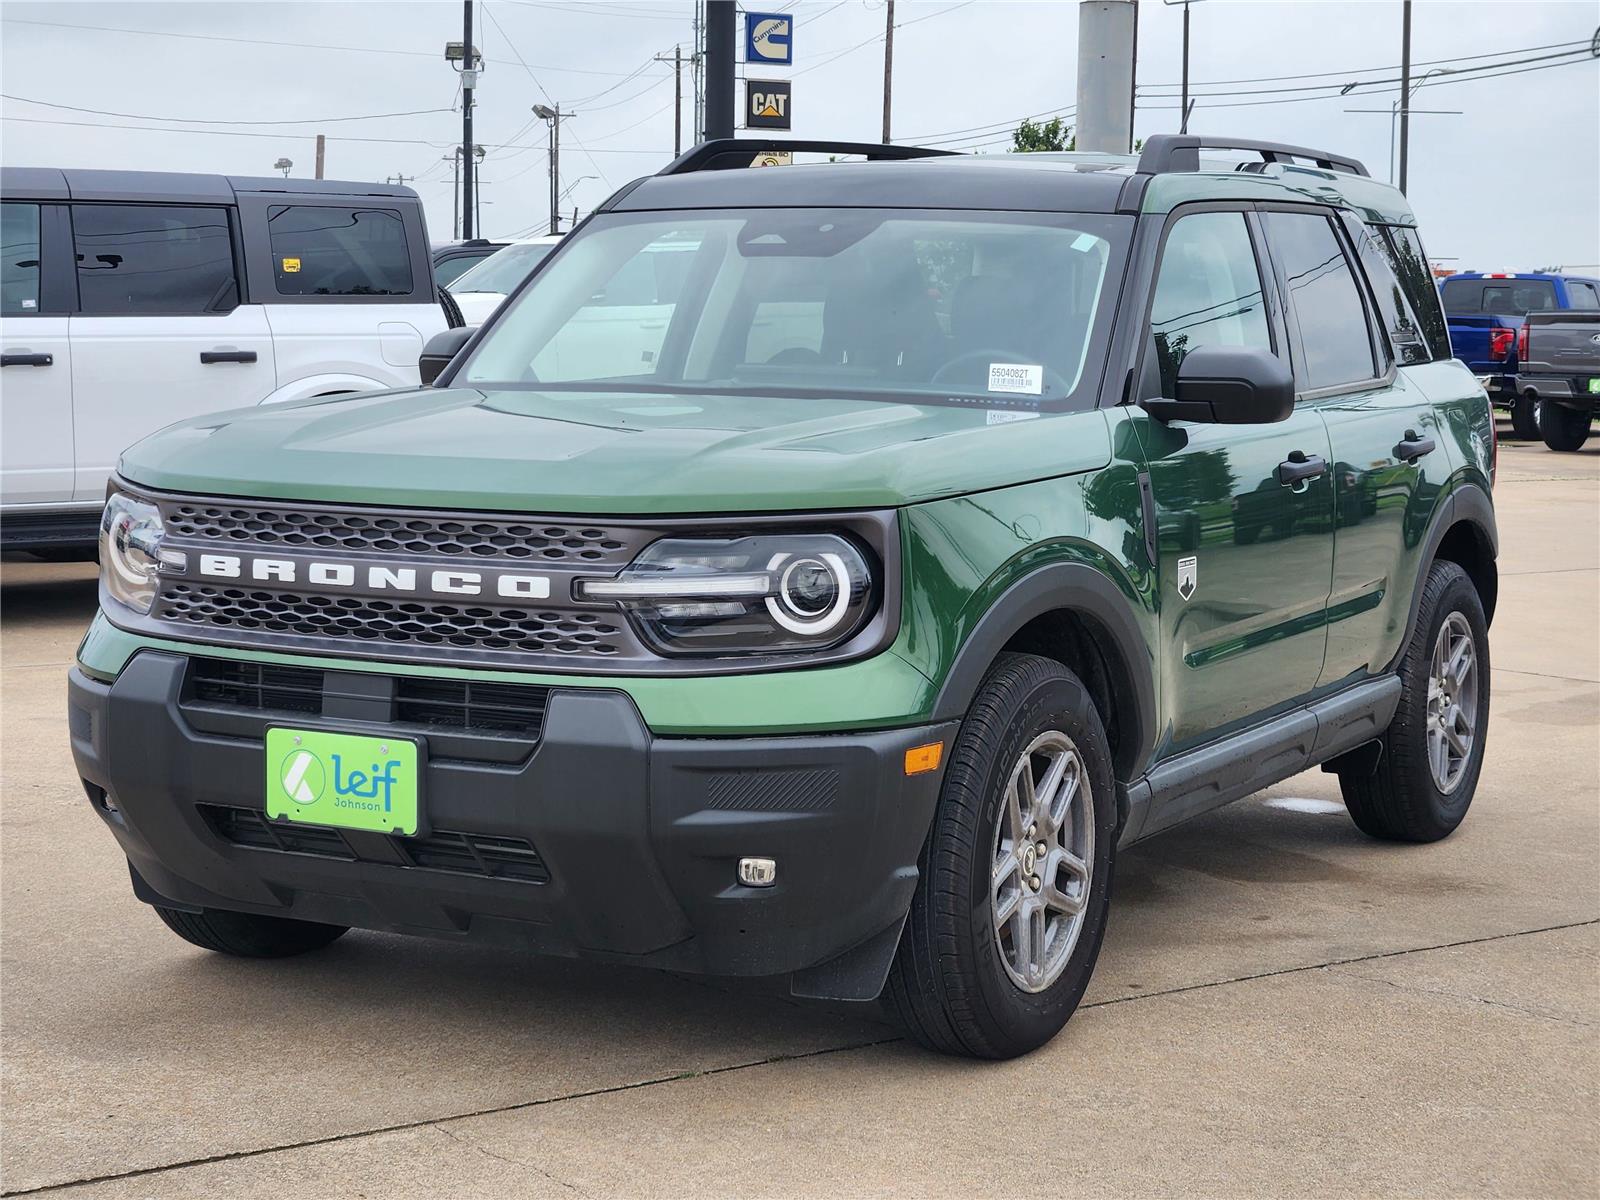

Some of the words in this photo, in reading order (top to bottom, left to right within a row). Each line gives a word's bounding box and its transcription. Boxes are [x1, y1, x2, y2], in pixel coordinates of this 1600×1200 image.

[753, 20, 785, 43] Cummins
[752, 92, 787, 116] CAT
[200, 554, 550, 599] BRONCO
[334, 797, 381, 812] Johnson
